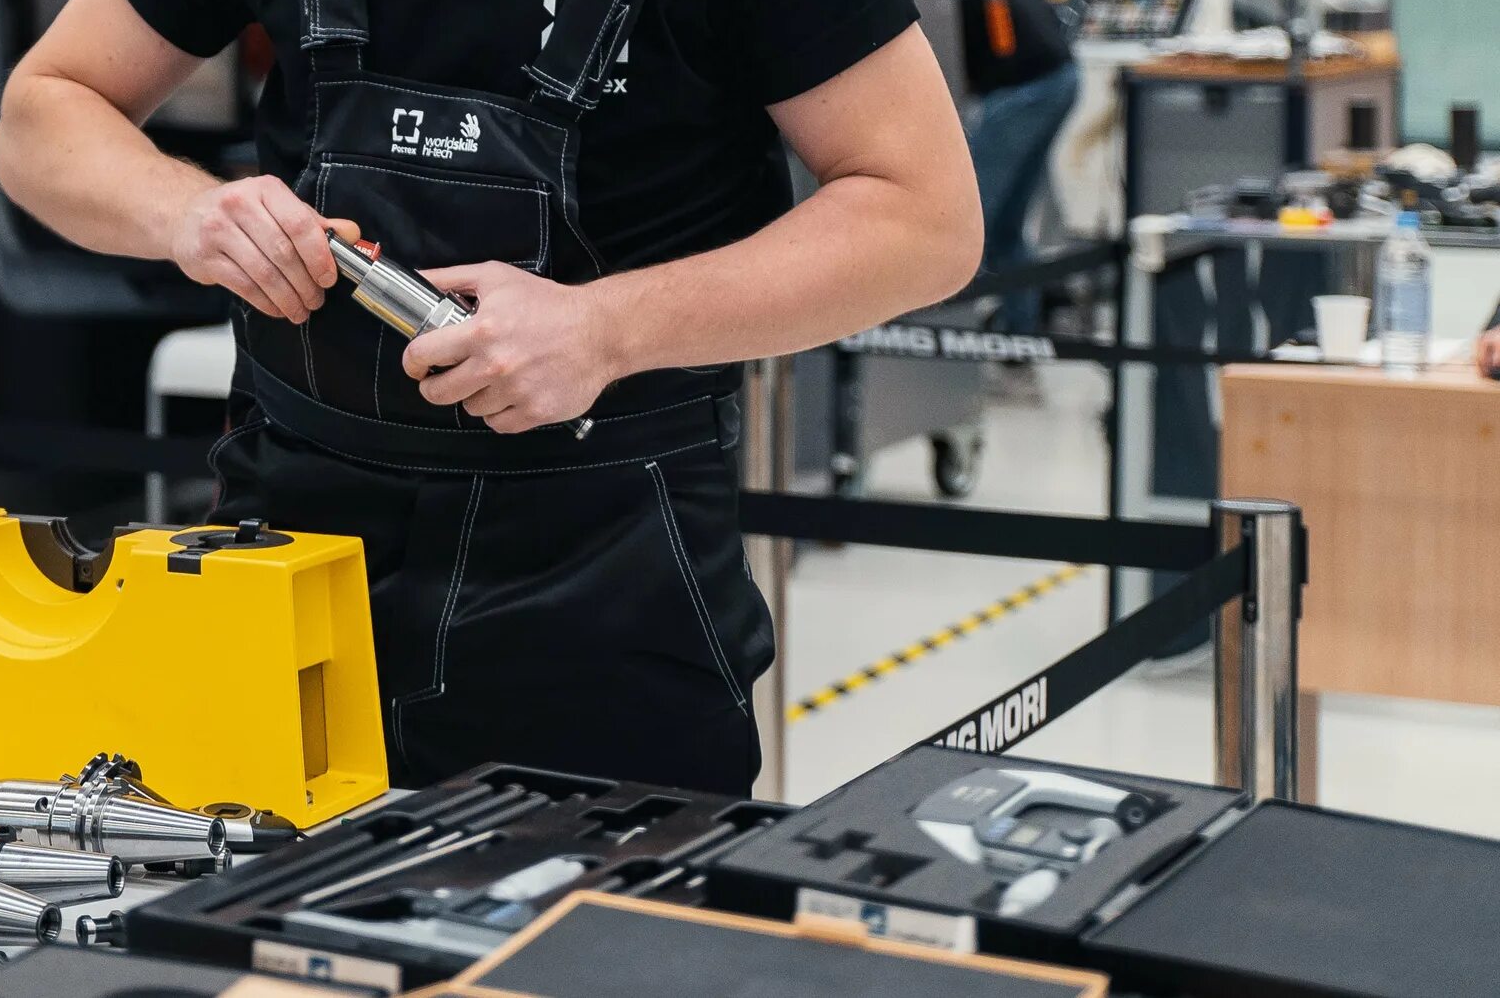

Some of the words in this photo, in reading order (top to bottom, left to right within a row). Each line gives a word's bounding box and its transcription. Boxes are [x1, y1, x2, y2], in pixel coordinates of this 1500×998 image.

[422, 144, 452, 159] hi-tech
[425, 136, 478, 152] worldskills
[941, 328, 1056, 361] MORI
[980, 676, 1047, 752] MORI
